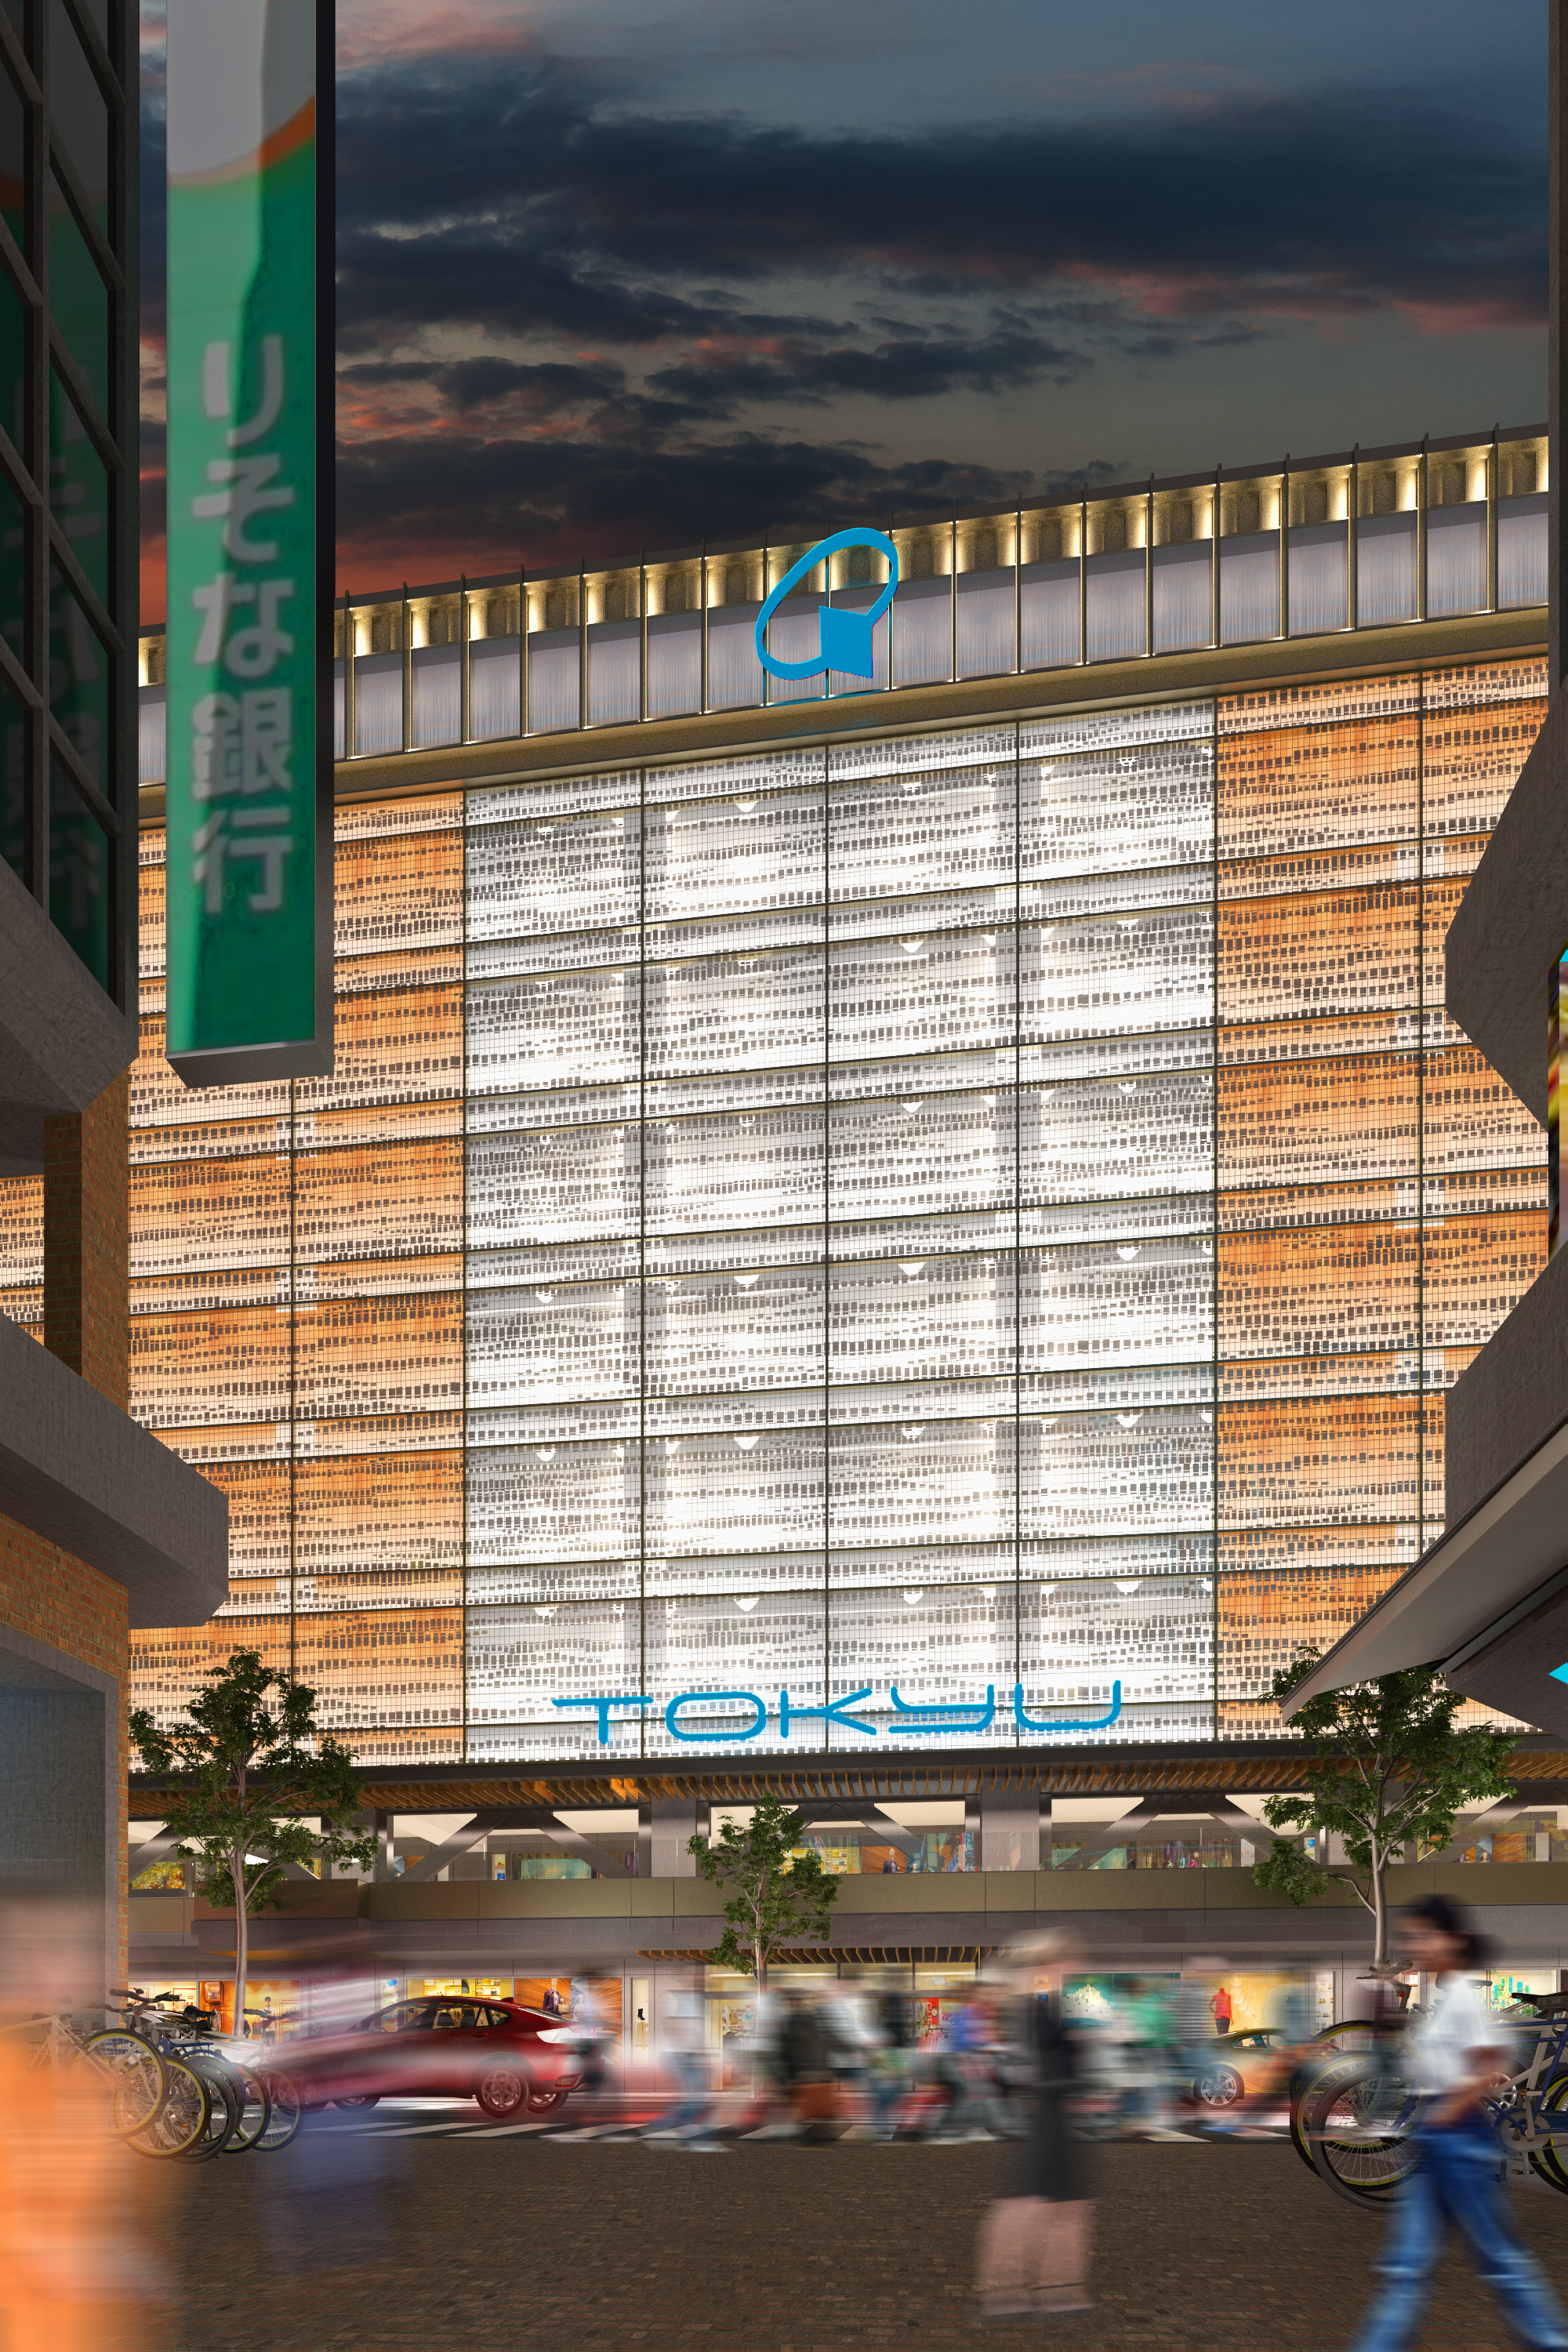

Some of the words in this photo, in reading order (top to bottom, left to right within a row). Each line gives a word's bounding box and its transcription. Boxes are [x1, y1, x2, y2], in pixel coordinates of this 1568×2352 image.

[191, 339, 294, 914] りそな銀行
[551, 1680, 1121, 1744] TOKYU
